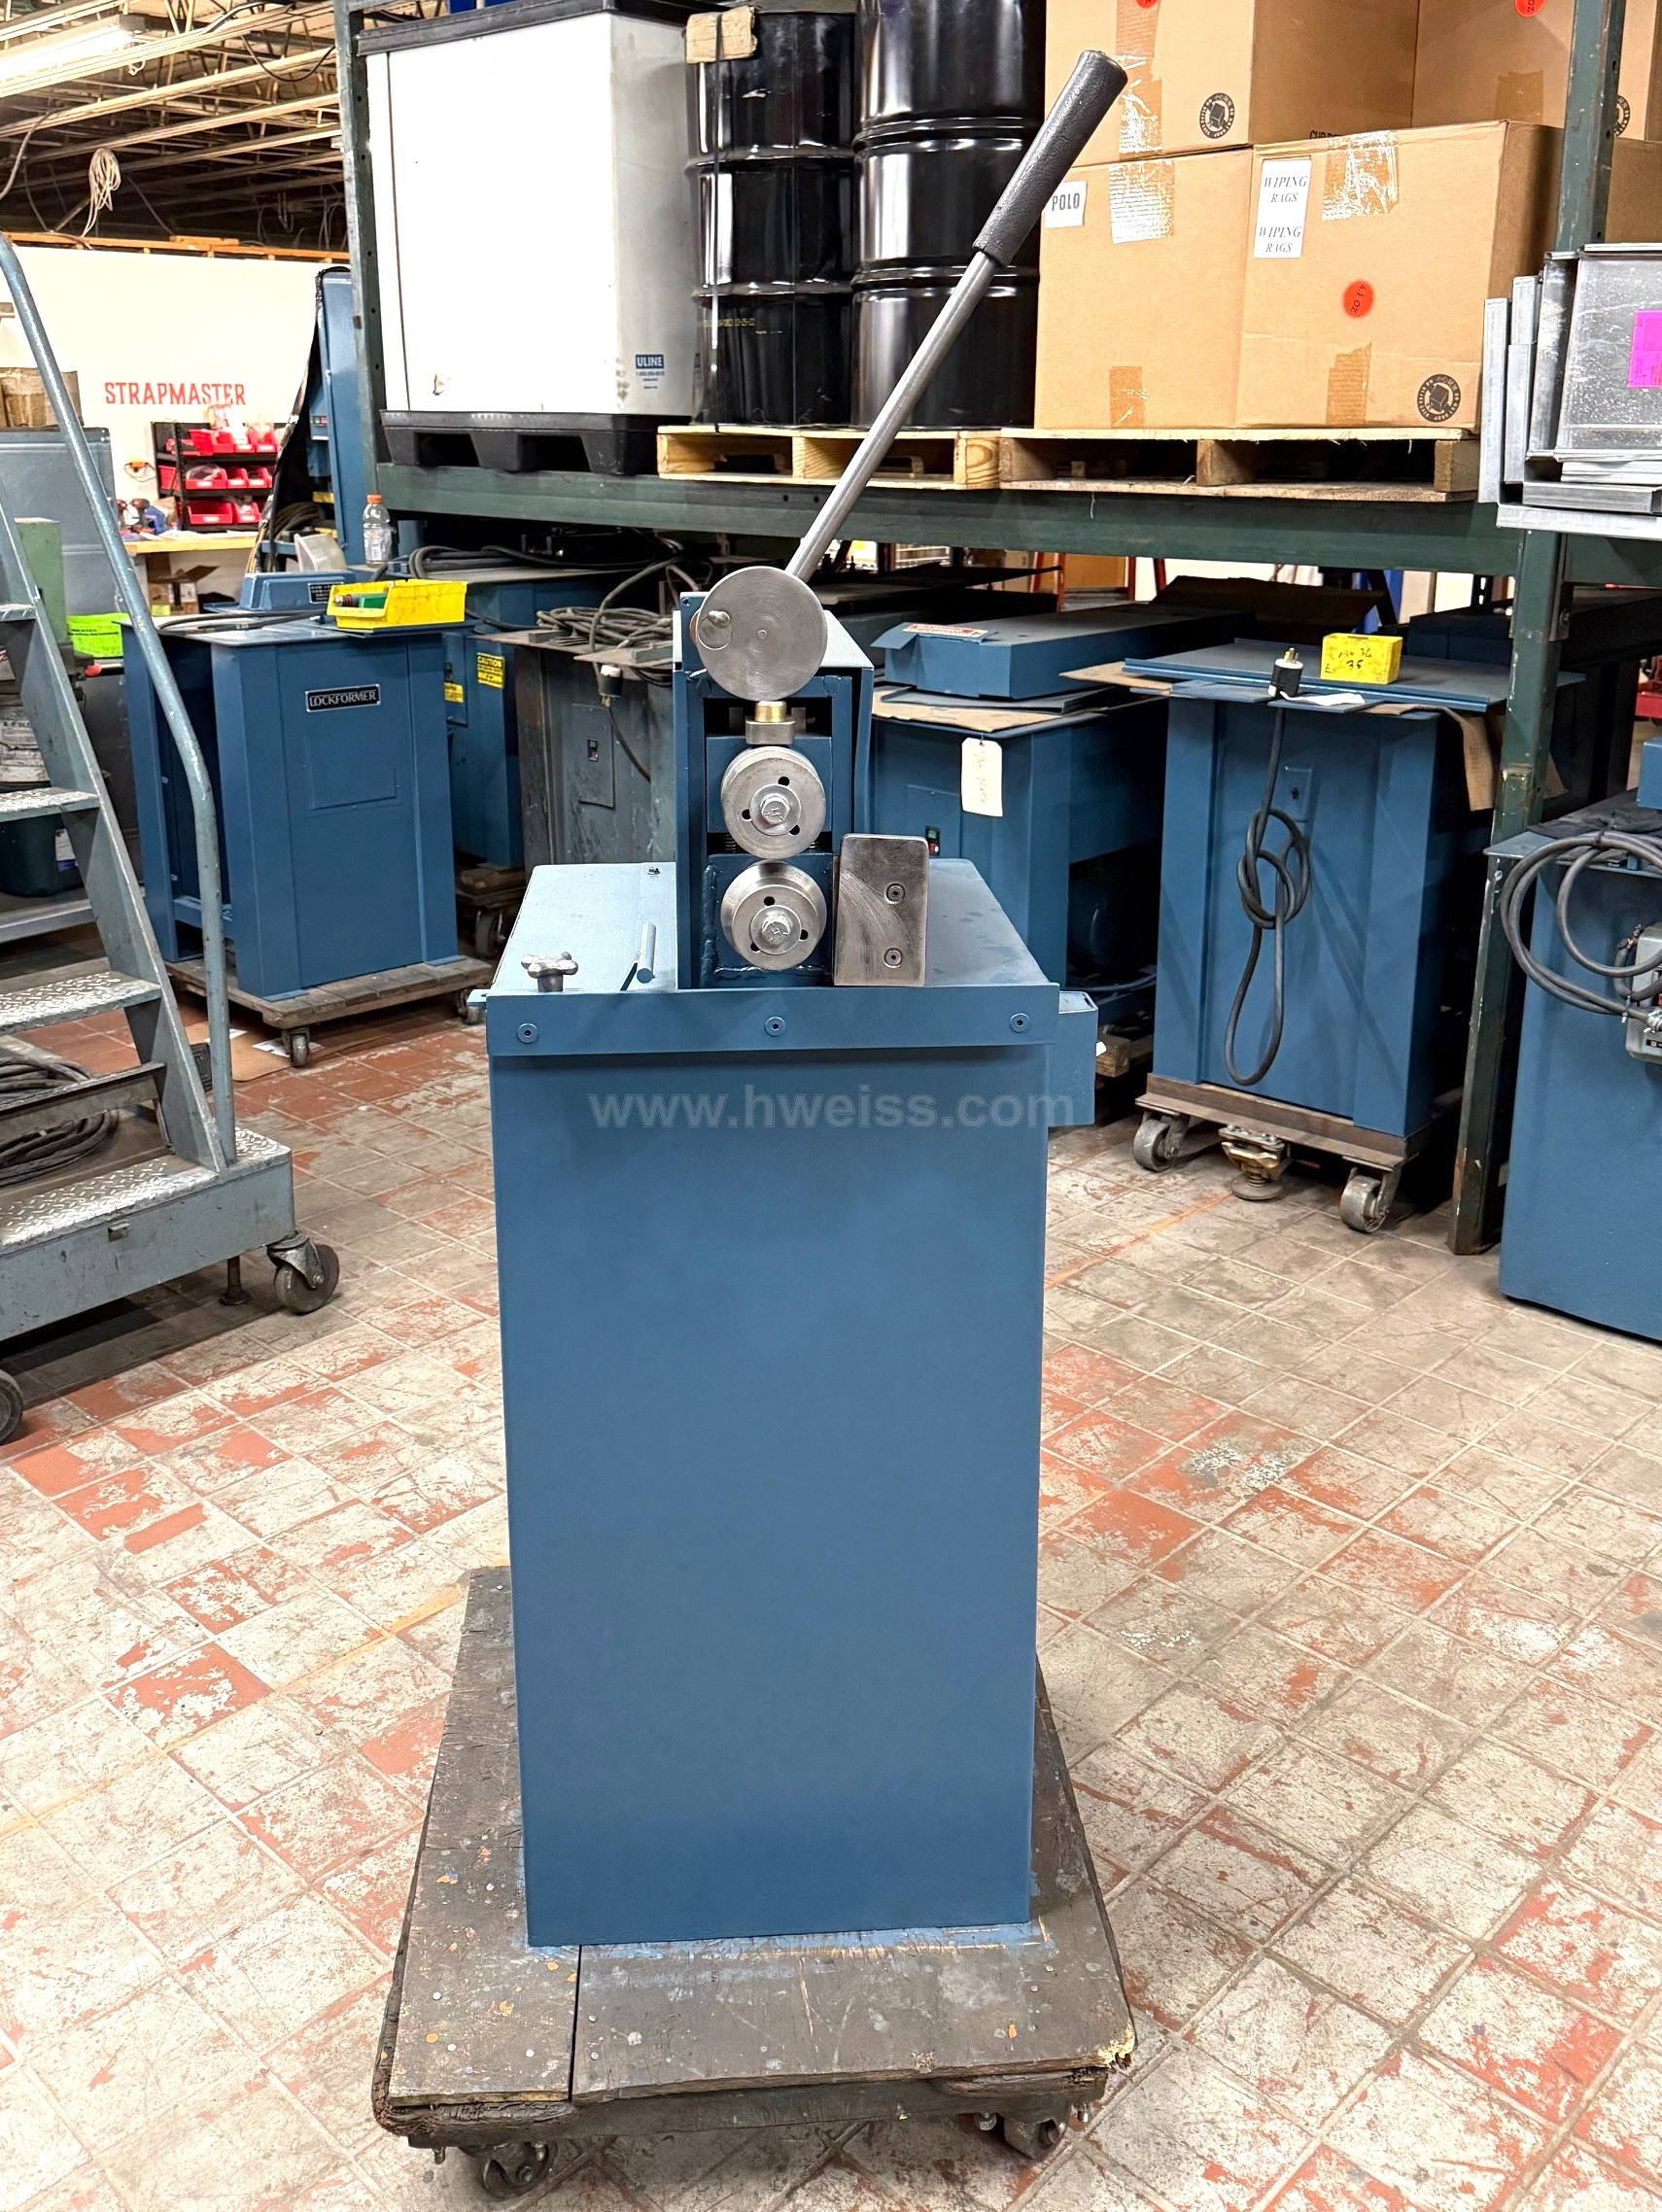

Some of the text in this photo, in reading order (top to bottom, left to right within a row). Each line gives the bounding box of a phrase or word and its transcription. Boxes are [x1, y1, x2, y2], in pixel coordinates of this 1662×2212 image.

[1264, 176, 1308, 189] WIPING
[1052, 192, 1081, 212] POLO
[1270, 192, 1299, 203] RAGS
[1259, 225, 1302, 238] WIPING
[1265, 242, 1294, 253] RAGS
[637, 356, 663, 367] ULINE
[104, 382, 246, 404] STRAPMASTER
[309, 689, 377, 707] LOCKFORMER
